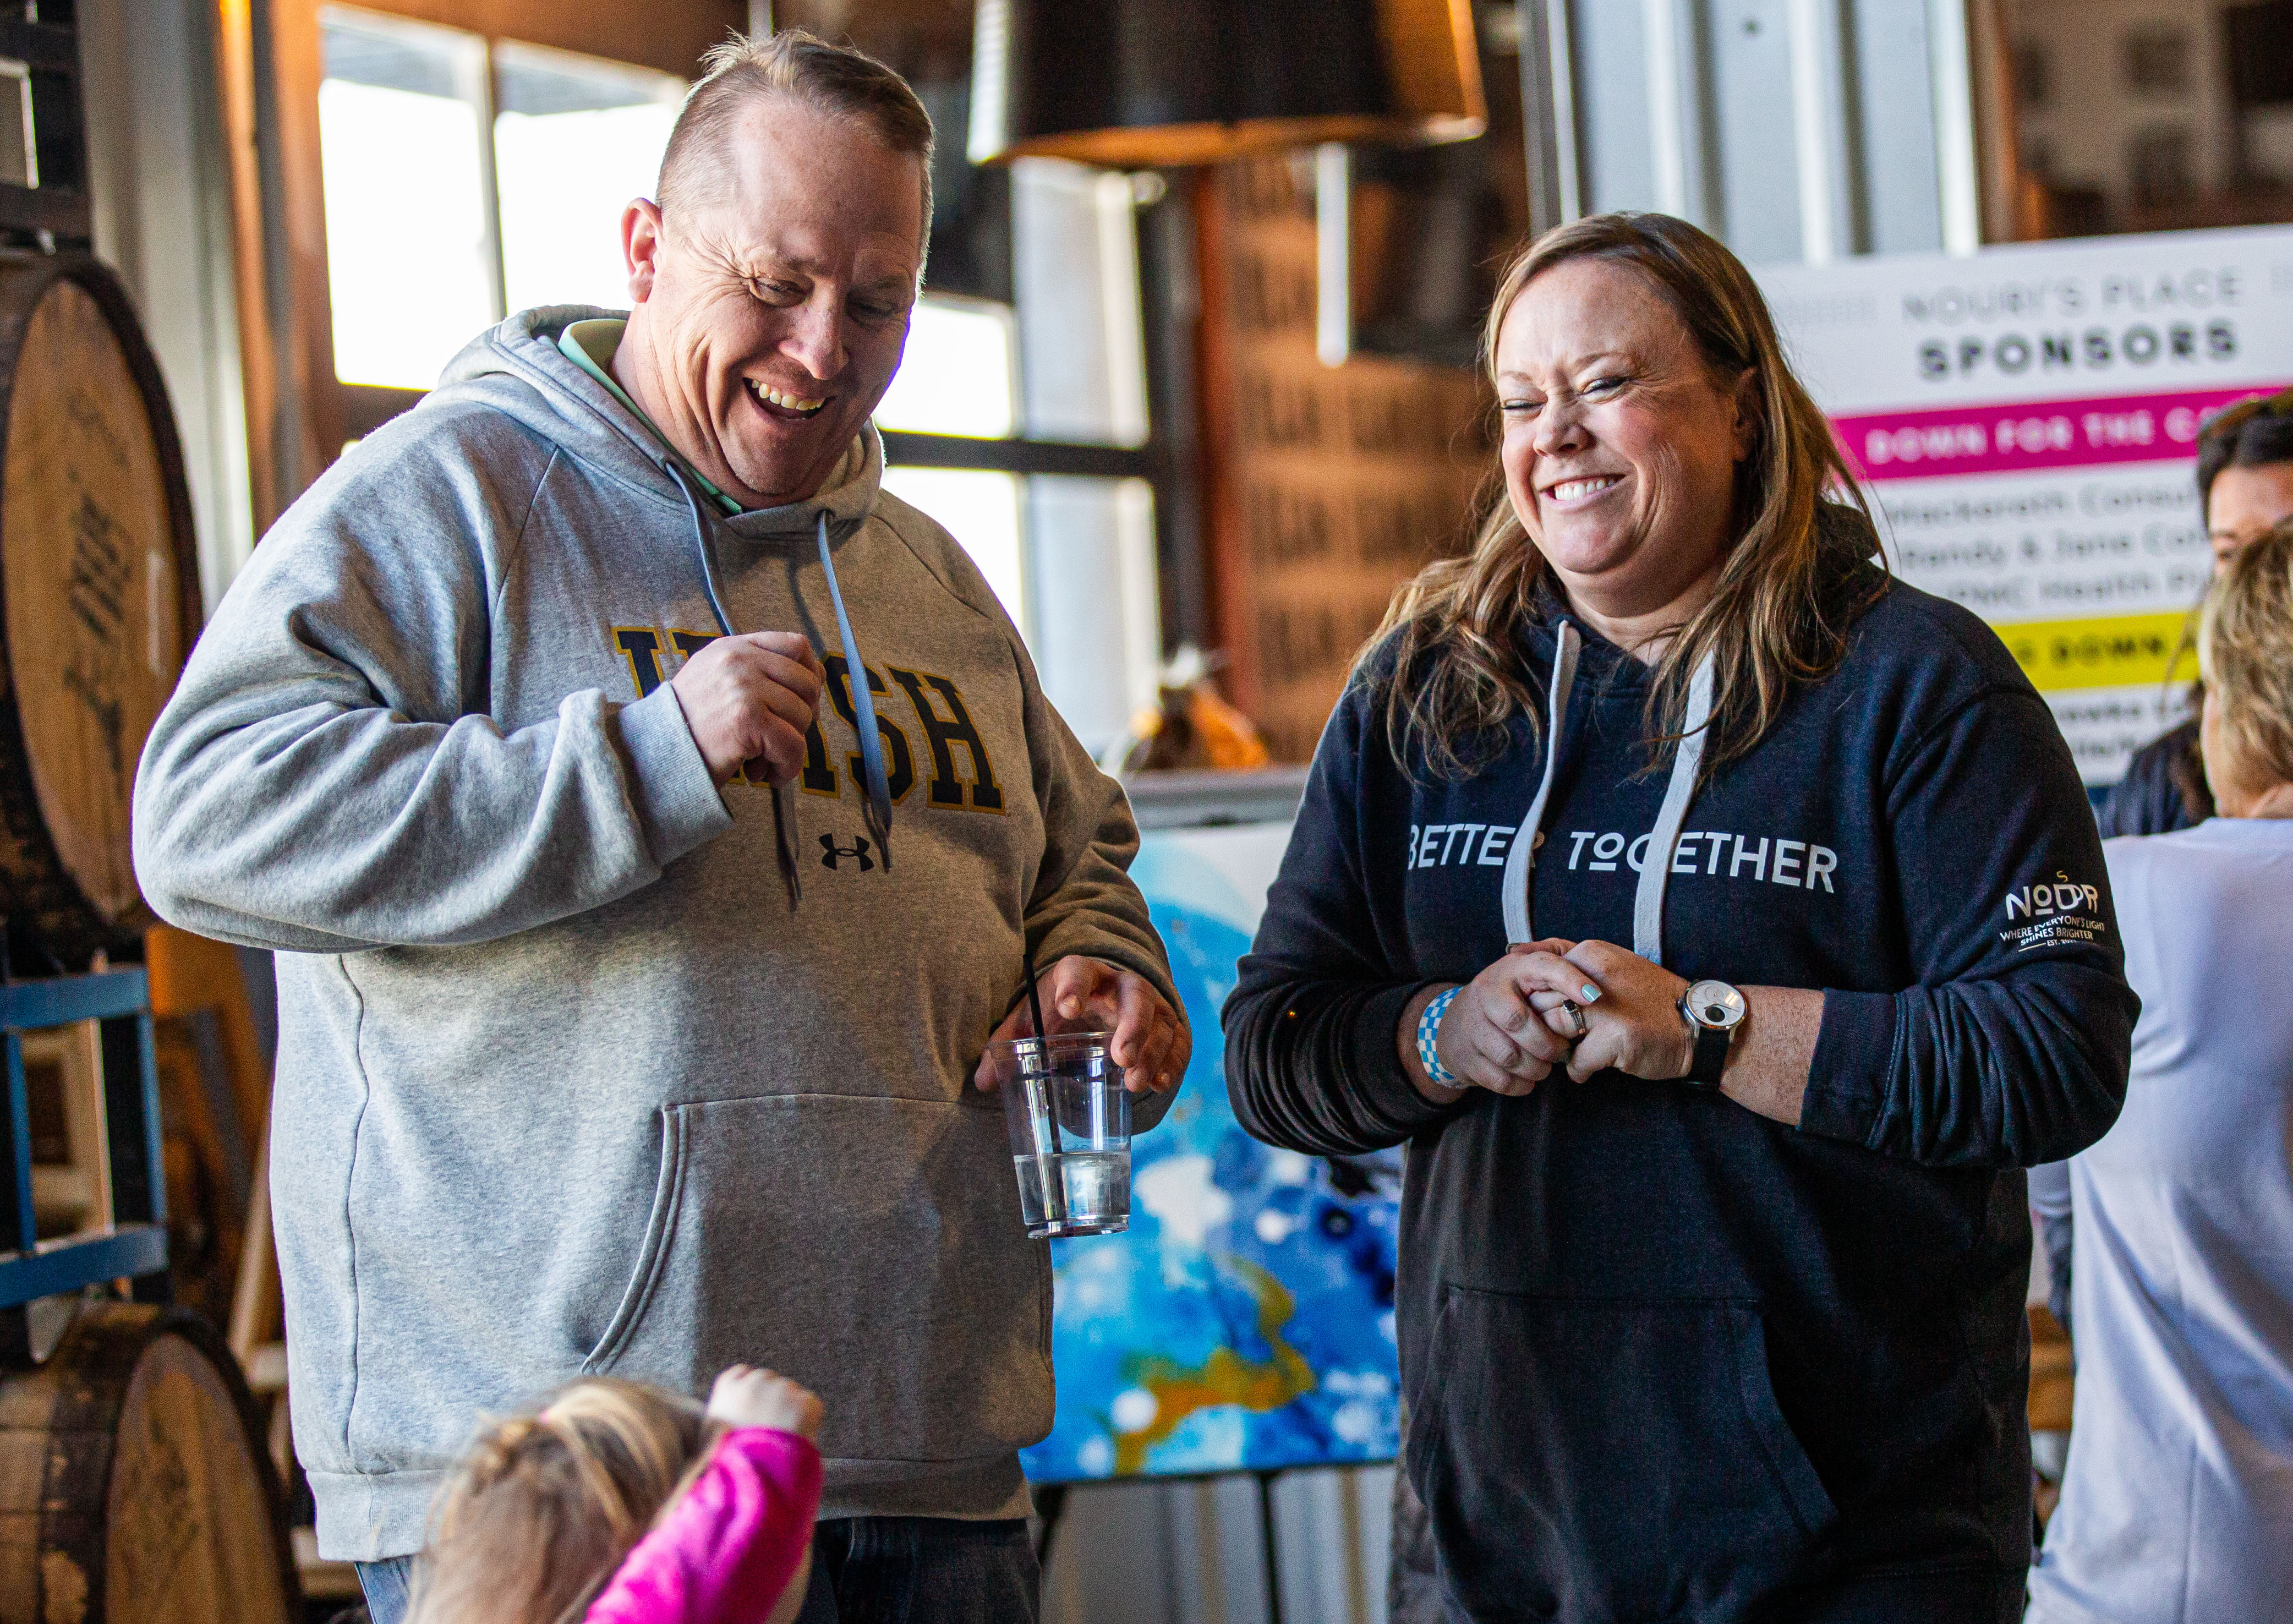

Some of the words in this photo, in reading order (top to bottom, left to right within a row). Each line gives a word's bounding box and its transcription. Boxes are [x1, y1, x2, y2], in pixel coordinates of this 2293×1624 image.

[2104, 267, 2245, 310] PLACE
[1917, 319, 2240, 381] SPONSORS
[1866, 423, 1988, 464] DOWN
[1996, 417, 2074, 453] FOR
[2082, 410, 2155, 447] THE
[611, 626, 1006, 816] ISH
[1408, 823, 1545, 870] BETTE
[2000, 927, 2033, 942] WHERE
[2034, 915, 2085, 932] EVERYONE'S
[2086, 920, 2104, 932] LIGHT
[2021, 927, 2054, 945] SHINES
[2056, 927, 2093, 941] BRIGHTER
